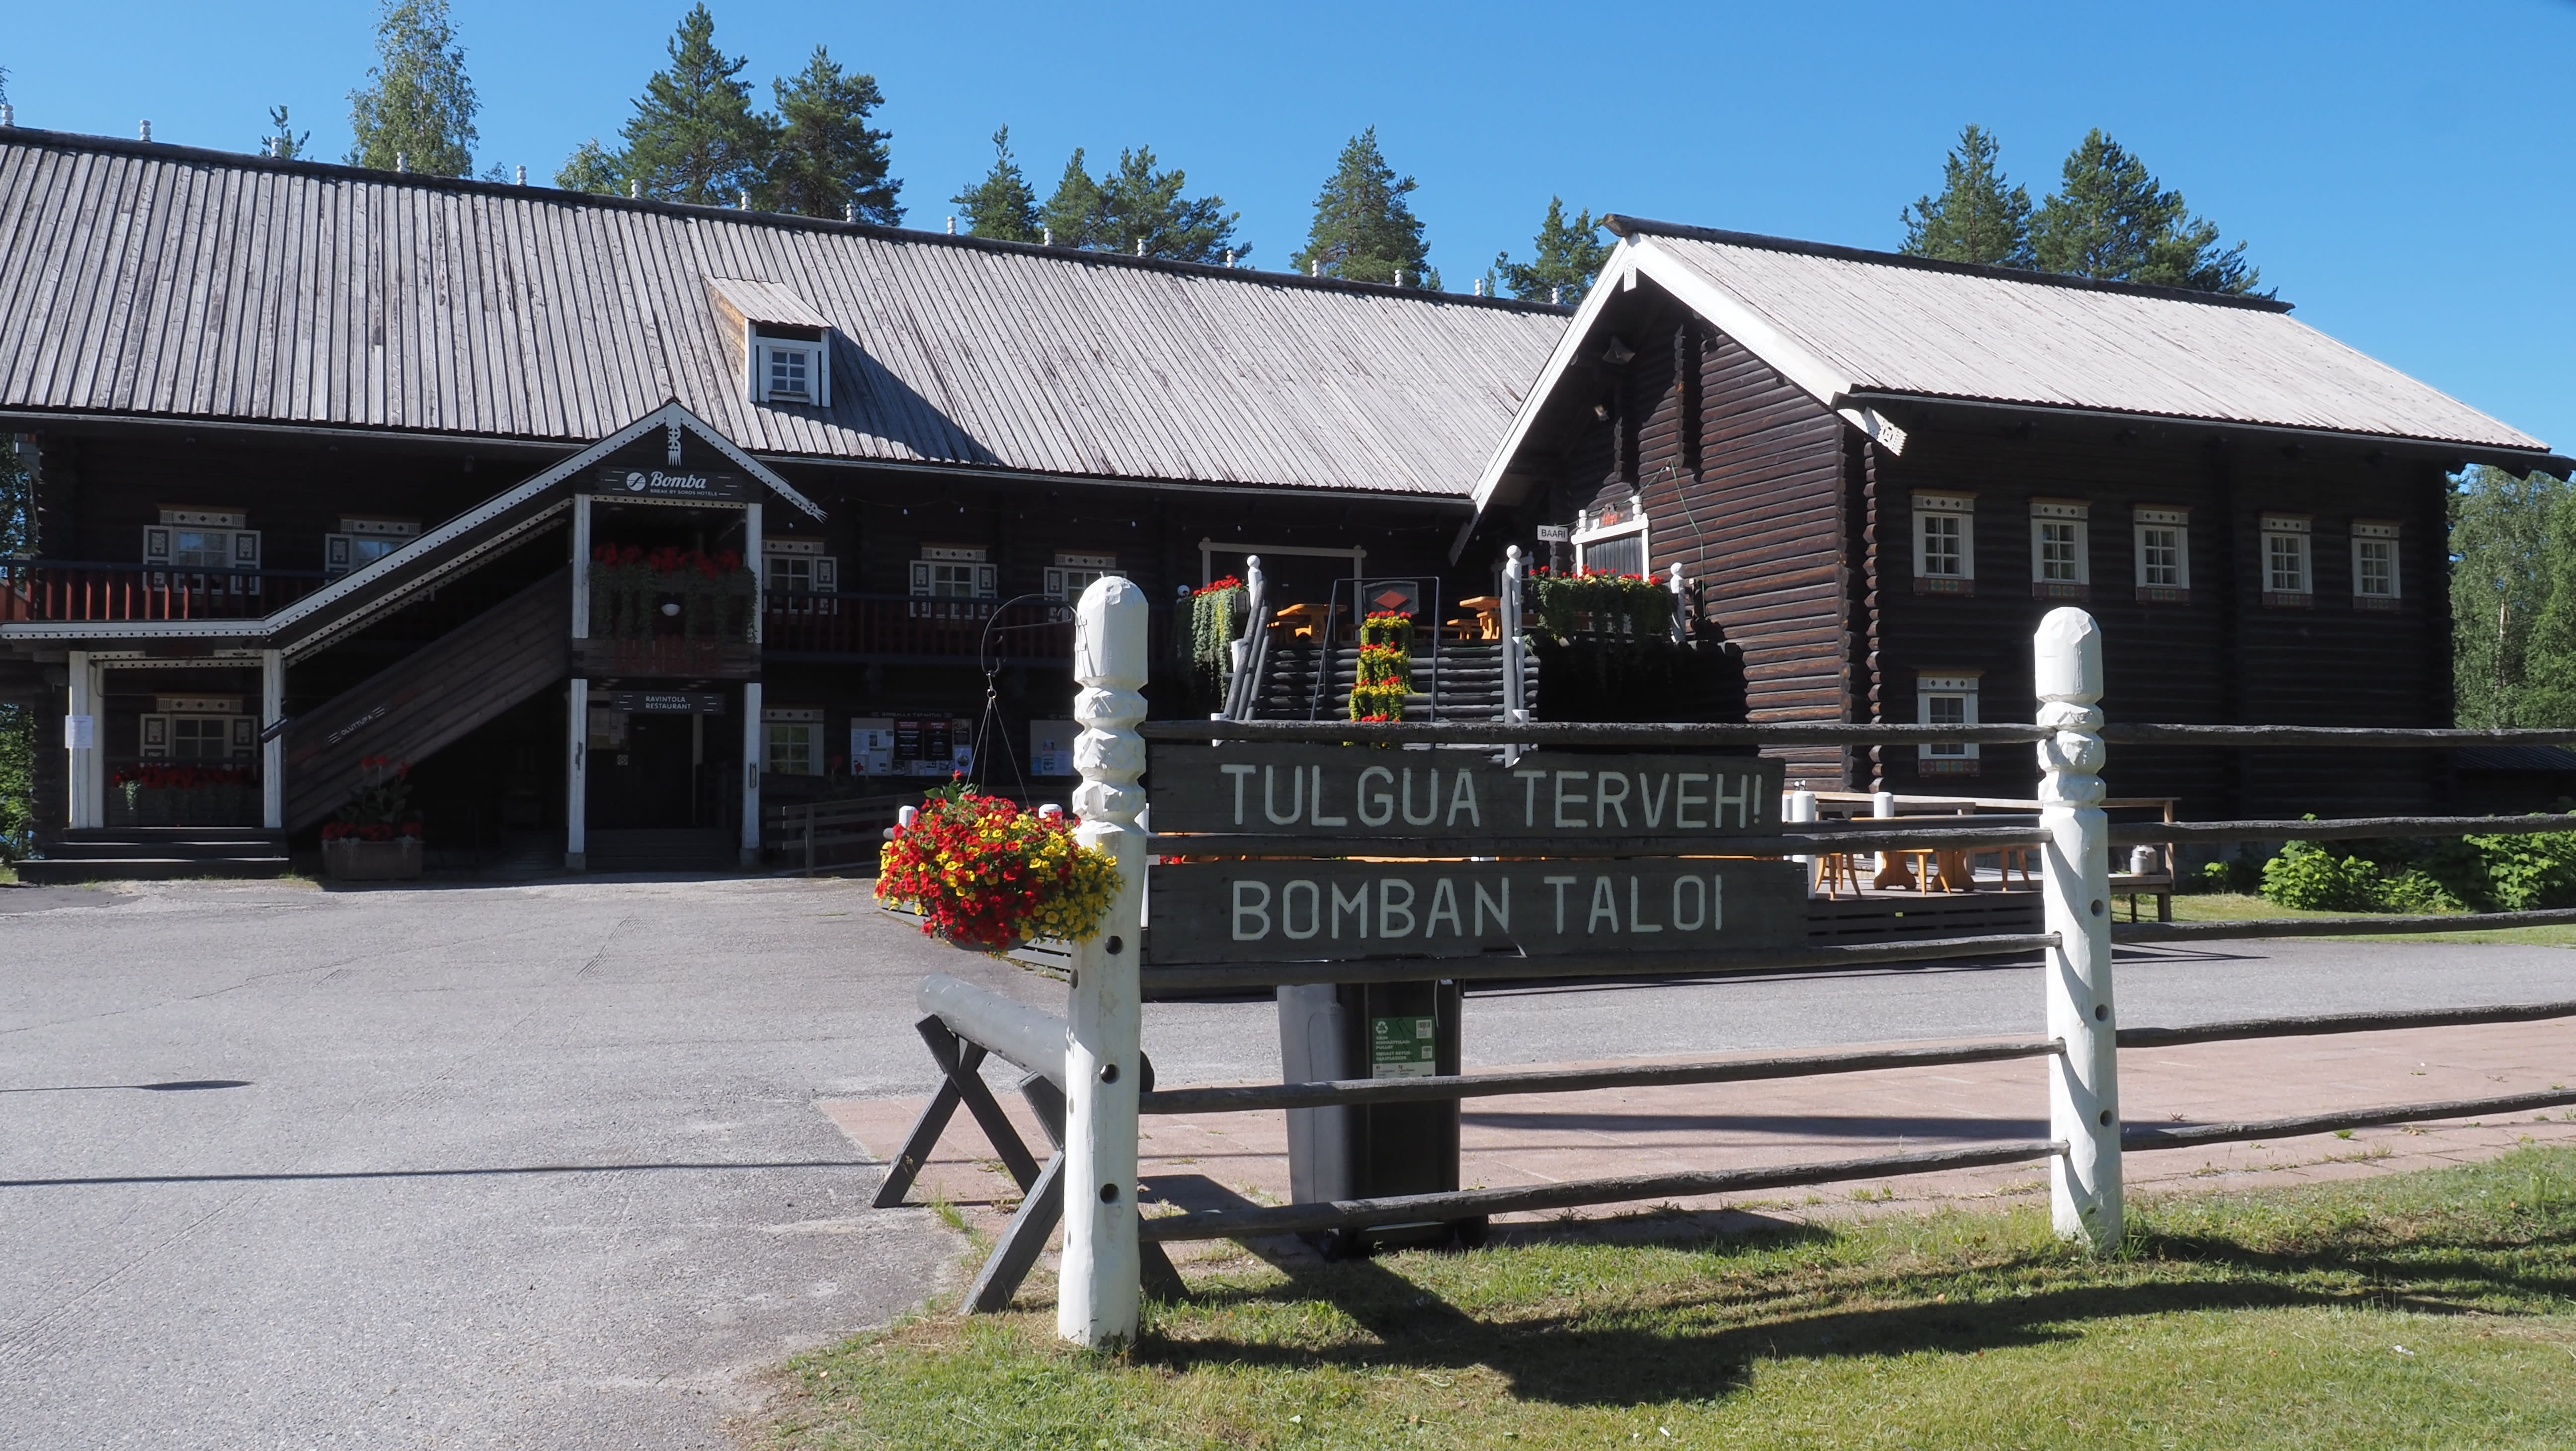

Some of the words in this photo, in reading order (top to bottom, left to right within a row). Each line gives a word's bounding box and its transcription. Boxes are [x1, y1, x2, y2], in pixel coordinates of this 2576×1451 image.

[650, 471, 706, 488] Bomba
[1541, 529, 1565, 538] BAARI
[341, 715, 373, 735] OLUTTUPA
[1220, 763, 1480, 828] TULGUA
[1513, 768, 1762, 829] TERVEH!
[1231, 878, 1510, 941] BOMBAN
[1543, 875, 1722, 935] TALOI
